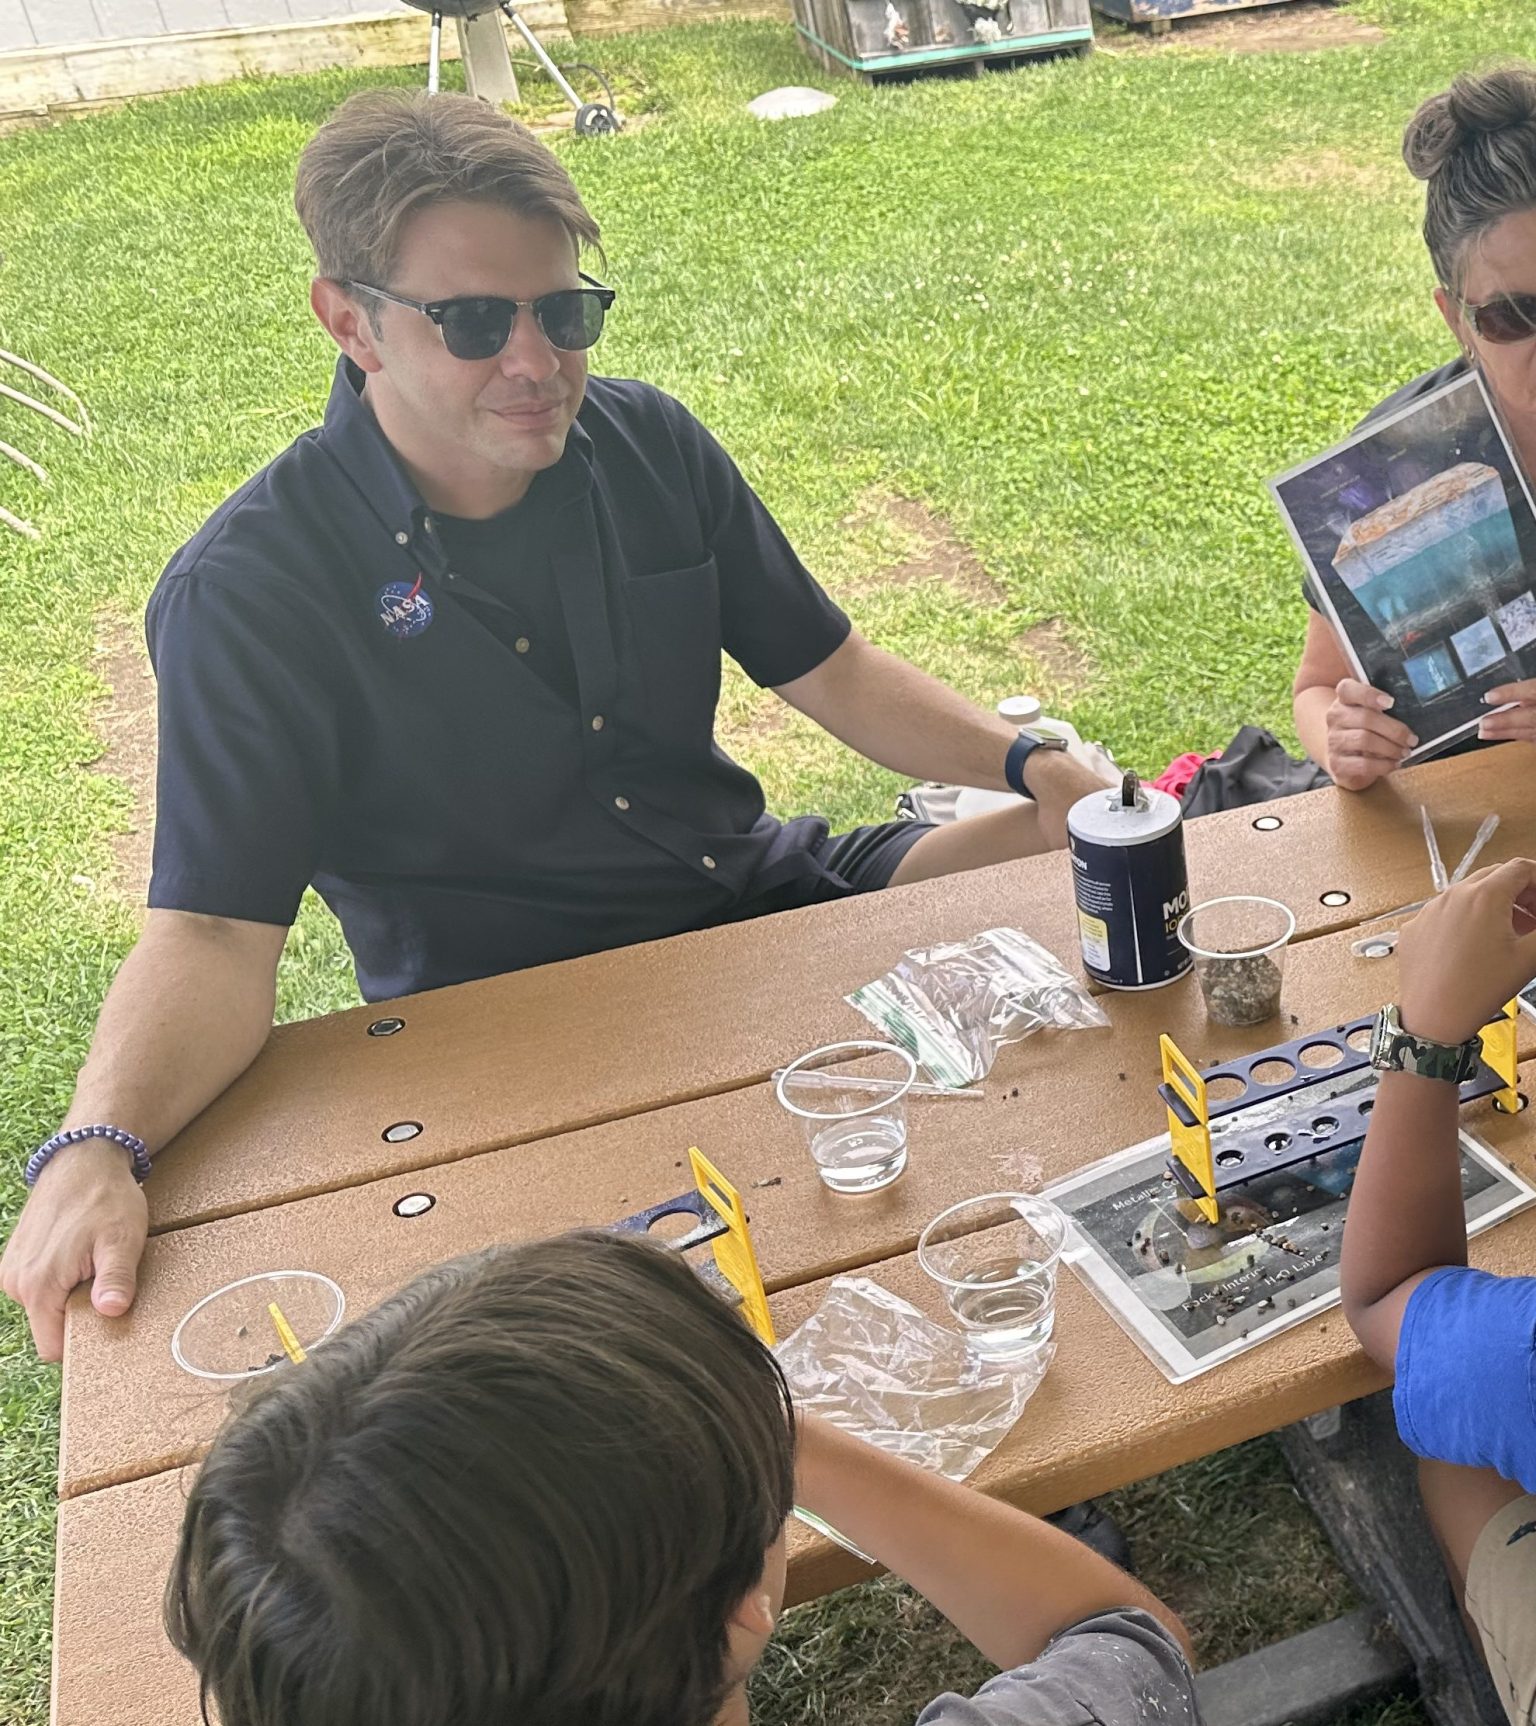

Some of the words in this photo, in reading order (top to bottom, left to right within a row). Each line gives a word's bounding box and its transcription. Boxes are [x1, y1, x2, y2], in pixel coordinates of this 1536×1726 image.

[380, 594, 430, 626] NASA
[1112, 1186, 1161, 1211] Metall
[1264, 1268, 1291, 1286] HO
[1293, 1247, 1329, 1272] Laye
[1181, 1288, 1219, 1312] Rock
